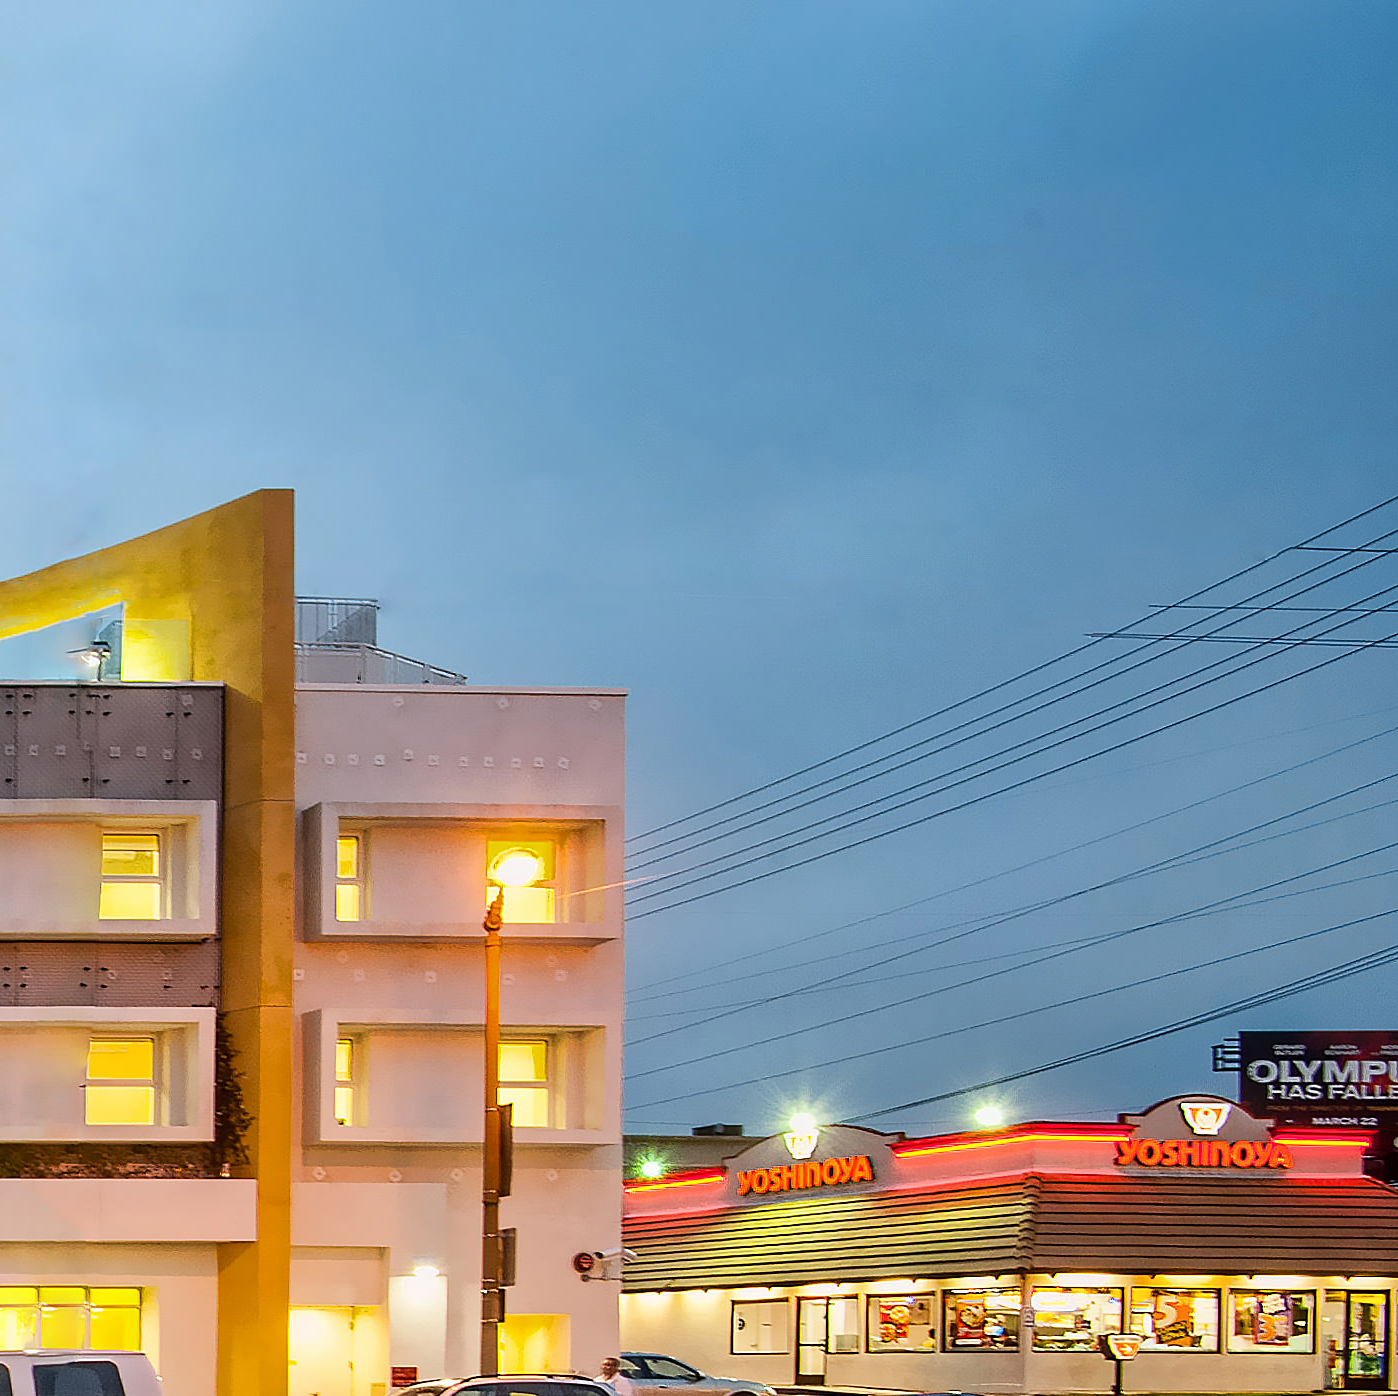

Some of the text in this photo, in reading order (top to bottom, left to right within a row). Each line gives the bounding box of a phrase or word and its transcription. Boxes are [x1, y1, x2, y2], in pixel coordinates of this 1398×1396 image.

[1267, 1085, 1322, 1100] HAS
[1311, 1117, 1379, 1126] MARCH 22
[1114, 1139, 1294, 1169] YOSHINOYA
[737, 1155, 874, 1196] YOSHINOYA
